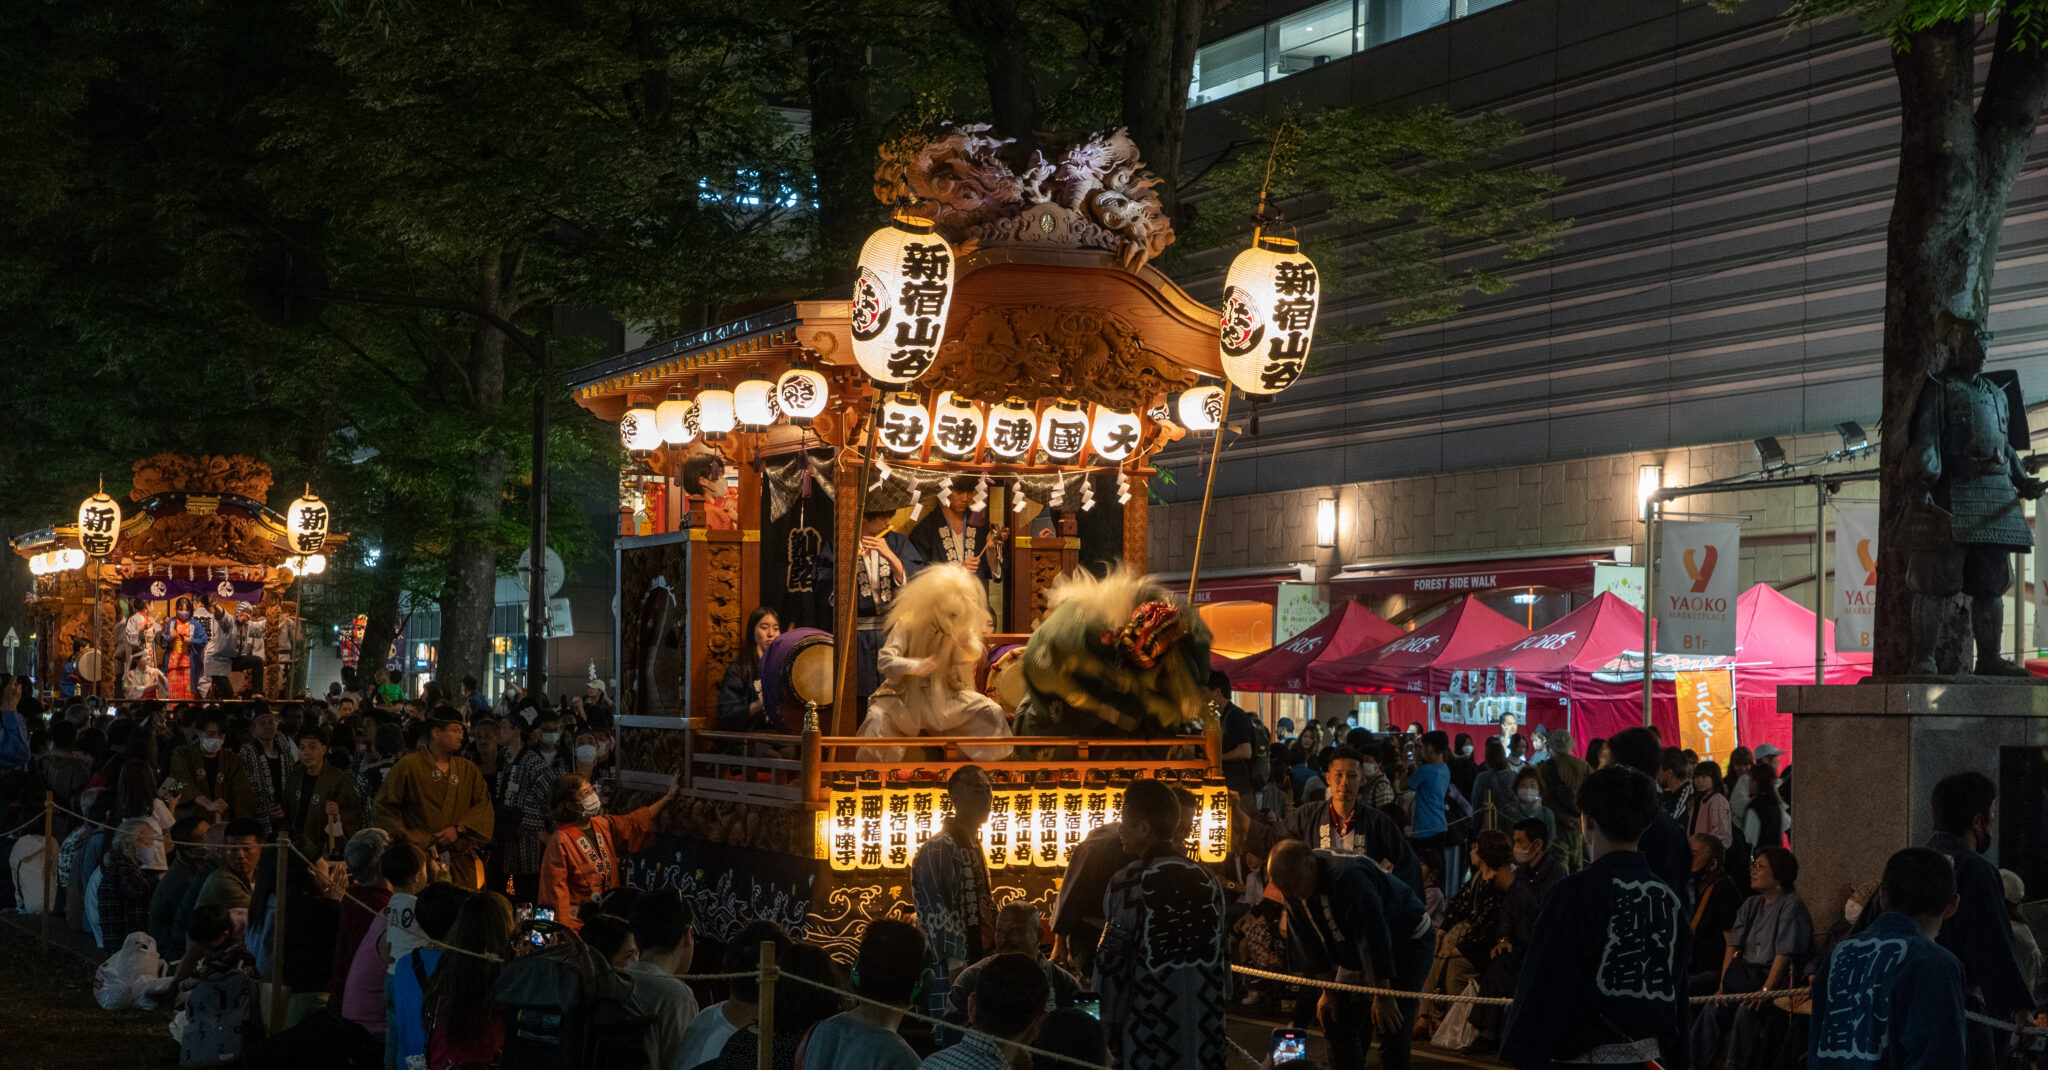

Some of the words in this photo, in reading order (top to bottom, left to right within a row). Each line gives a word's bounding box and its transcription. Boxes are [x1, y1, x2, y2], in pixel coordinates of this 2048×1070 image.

[887, 242, 951, 378] 新宿山谷
[1260, 261, 1317, 389] 新宿山谷
[82, 506, 115, 554] 新宿
[297, 506, 327, 552] 新宿
[1414, 578, 1447, 590] FOREST
[1449, 577, 1468, 588] SIDE
[1471, 575, 1496, 587] WALK
[1670, 596, 1727, 612] YAOKO
[1845, 590, 1876, 606] YAO
[1669, 612, 1726, 621] MARKETPLACE
[1683, 635, 1709, 649] B1F
[888, 794, 909, 865] 新宿山谷
[913, 793, 933, 845] 新宿山
[990, 796, 1010, 865] 新宿山谷
[1014, 794, 1033, 861] 新宿山谷
[1038, 793, 1057, 861] 新宿山谷
